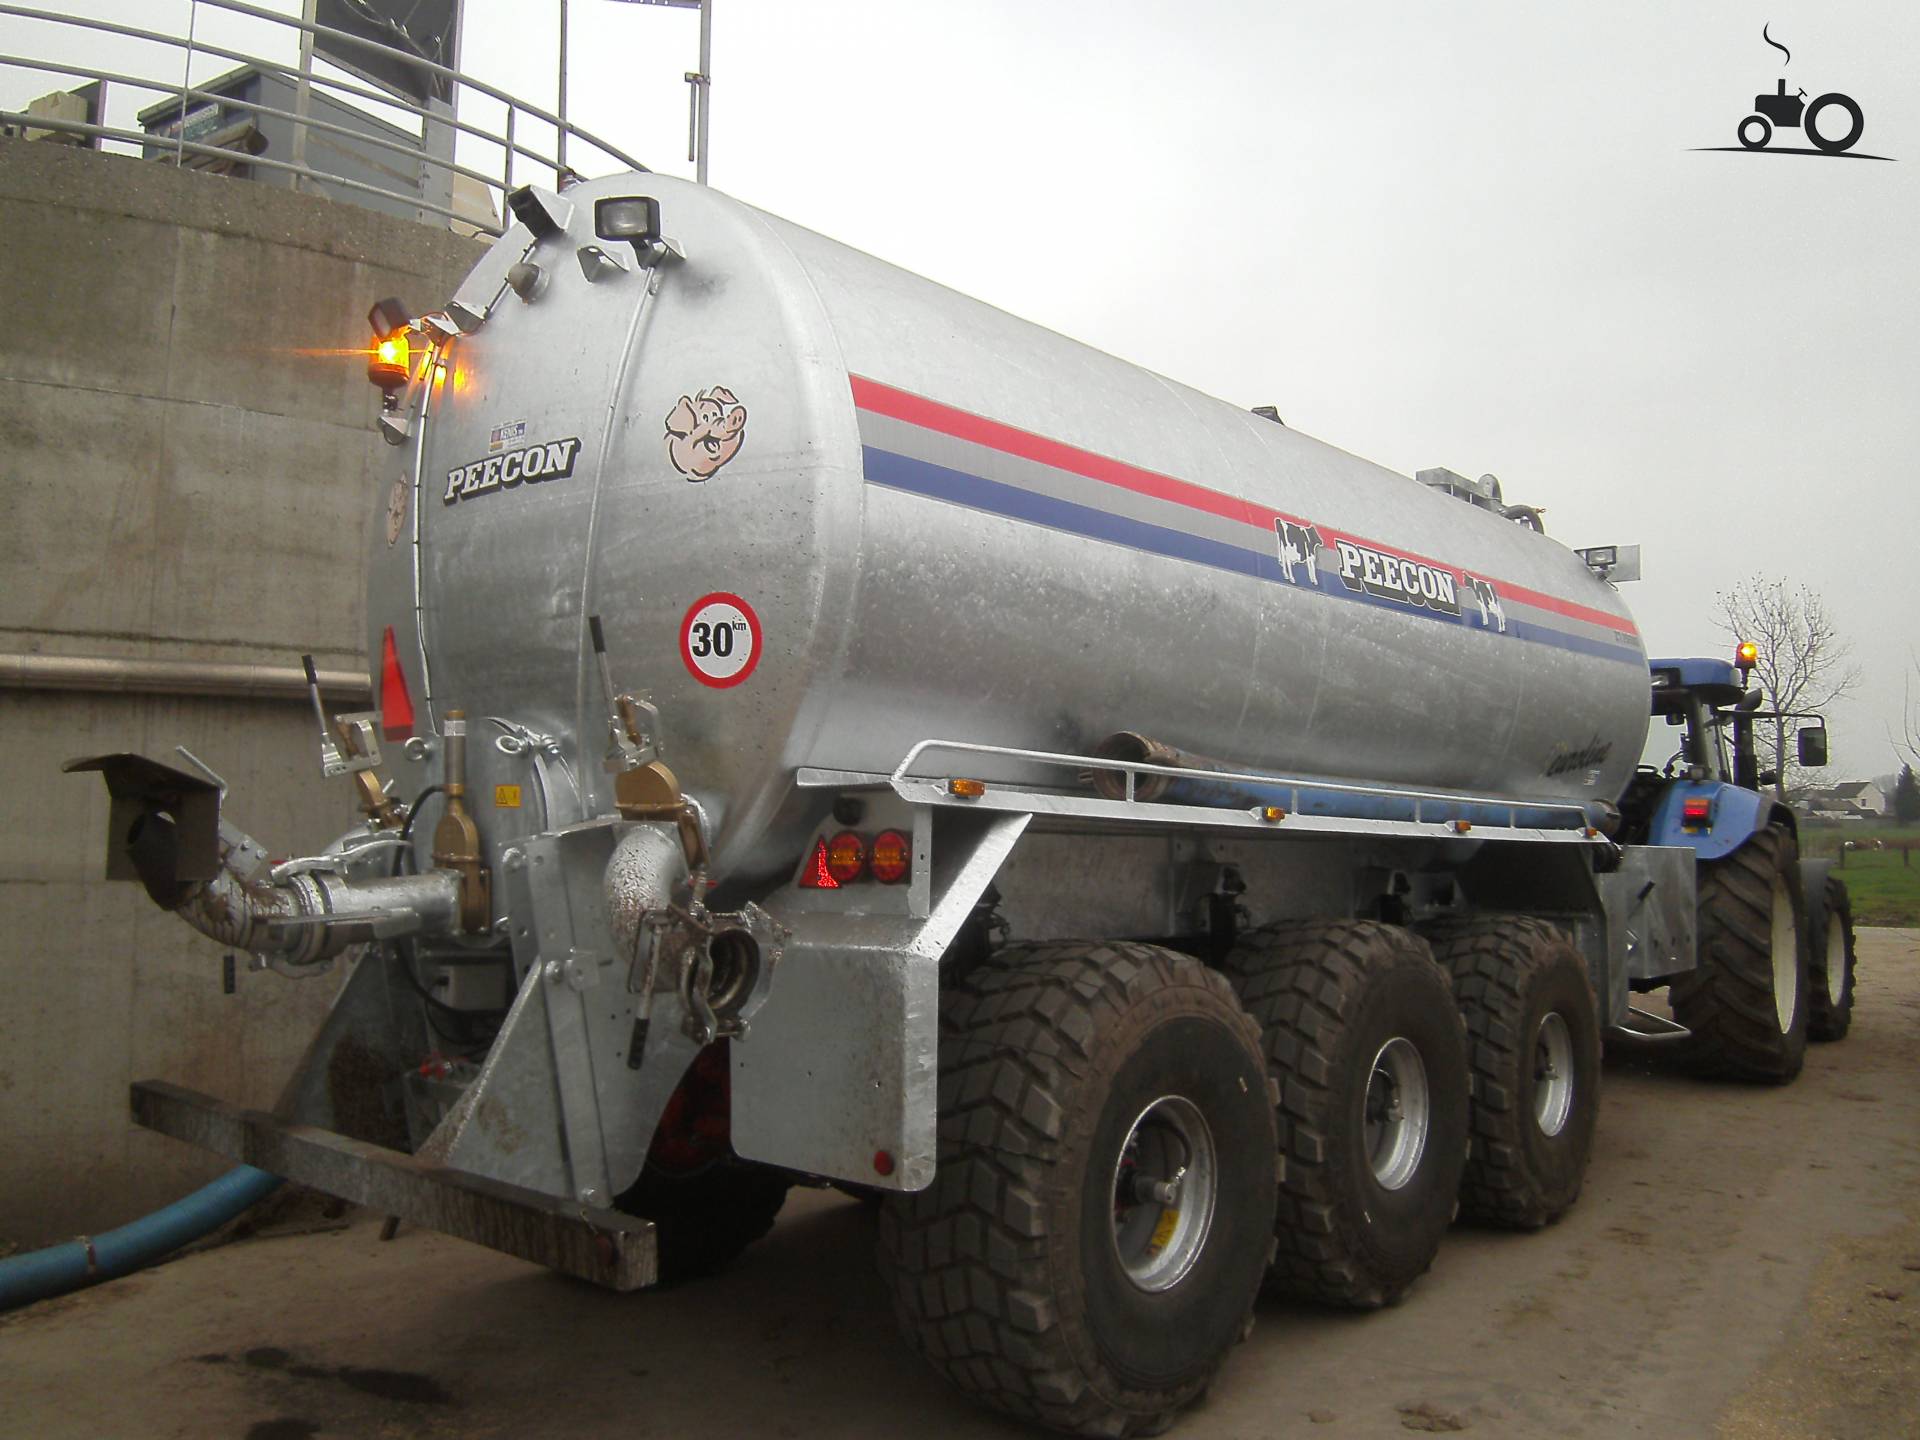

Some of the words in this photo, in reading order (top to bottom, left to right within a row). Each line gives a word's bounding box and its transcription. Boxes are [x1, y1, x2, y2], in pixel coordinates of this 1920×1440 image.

[444, 438, 581, 504] PEECON
[1336, 540, 1459, 612] PEECON
[692, 622, 733, 657] 30
[732, 621, 747, 631] km
